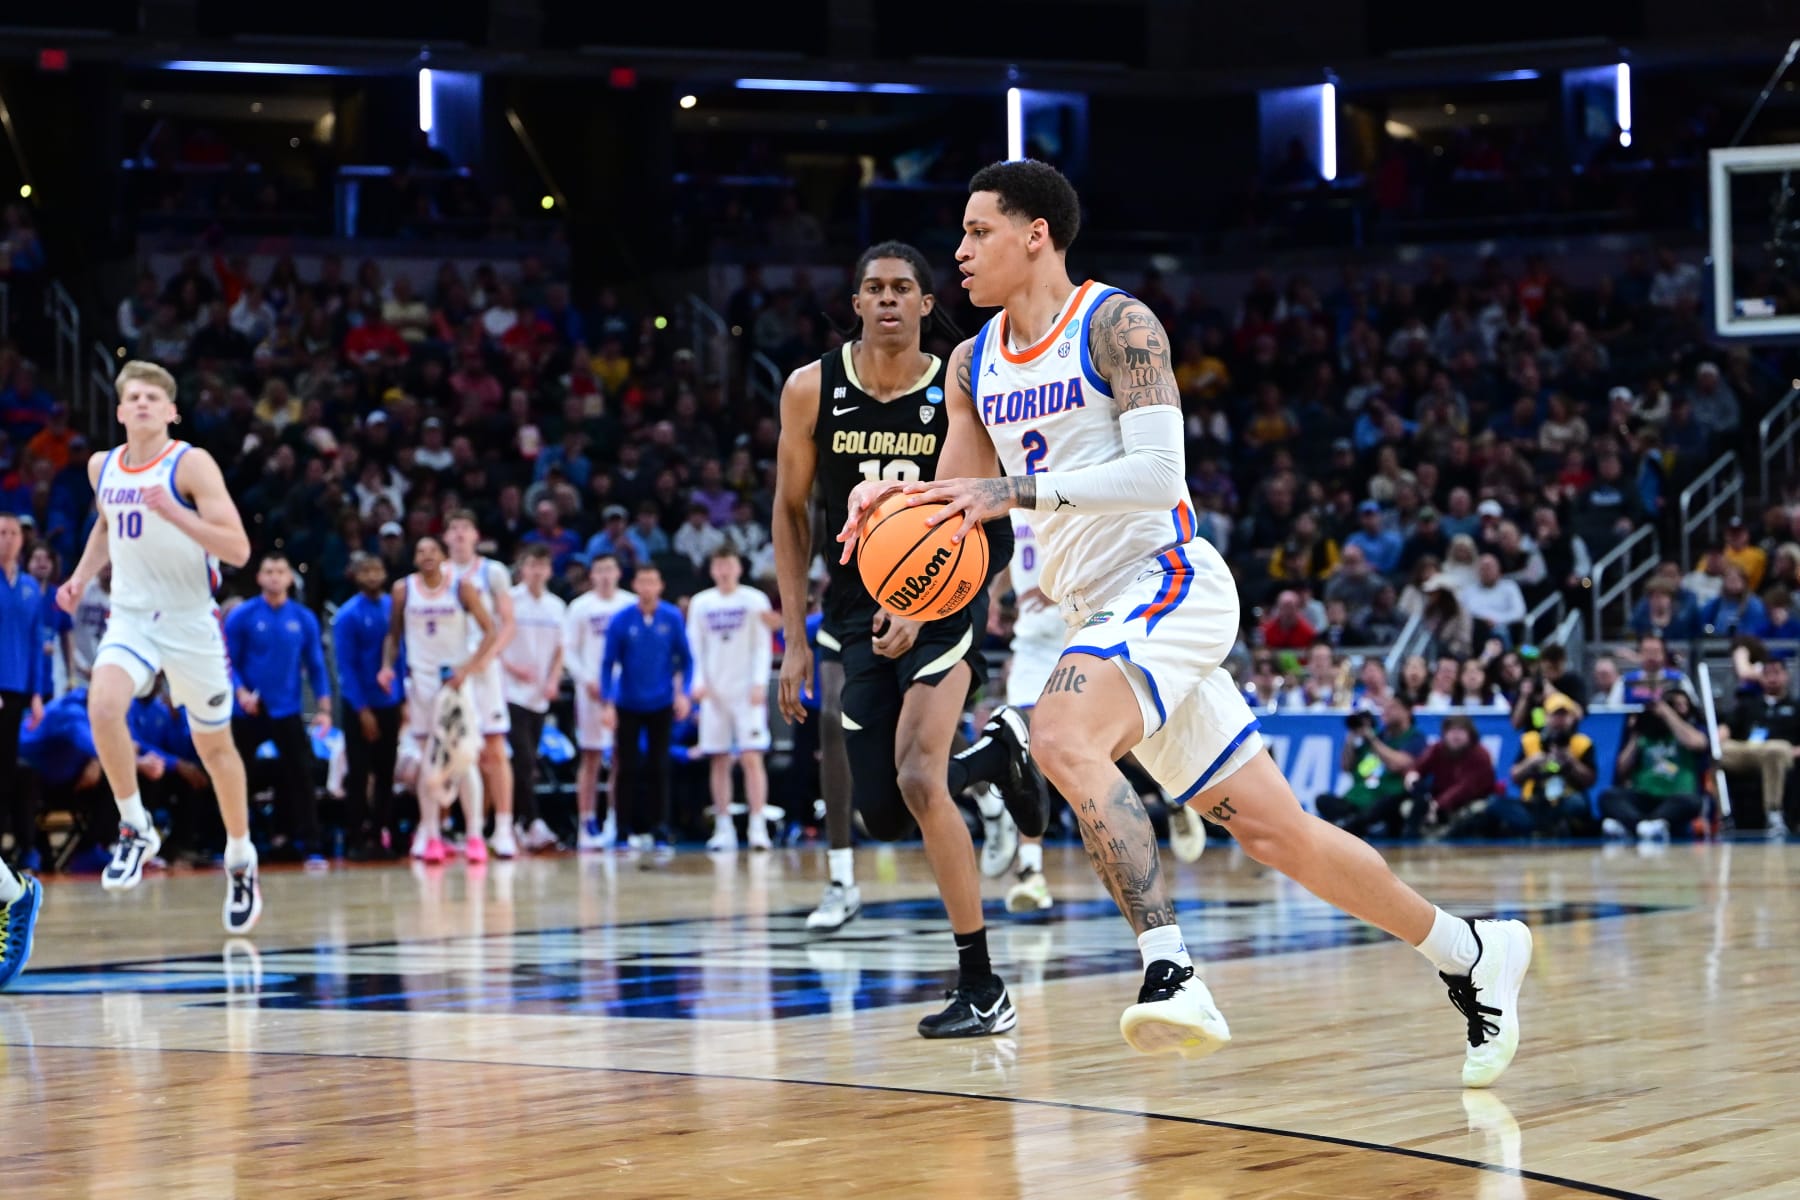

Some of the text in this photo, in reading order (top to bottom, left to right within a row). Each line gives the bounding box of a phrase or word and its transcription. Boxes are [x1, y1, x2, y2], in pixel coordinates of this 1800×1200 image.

[983, 376, 1086, 427] FLORIDA
[832, 430, 937, 456] COLORADO
[1021, 430, 1049, 476] 2
[102, 487, 145, 505] FLORI
[117, 511, 143, 539] 10
[885, 547, 952, 611] Wilson
[1080, 798, 1097, 816] HA
[1107, 837, 1133, 861] HA
